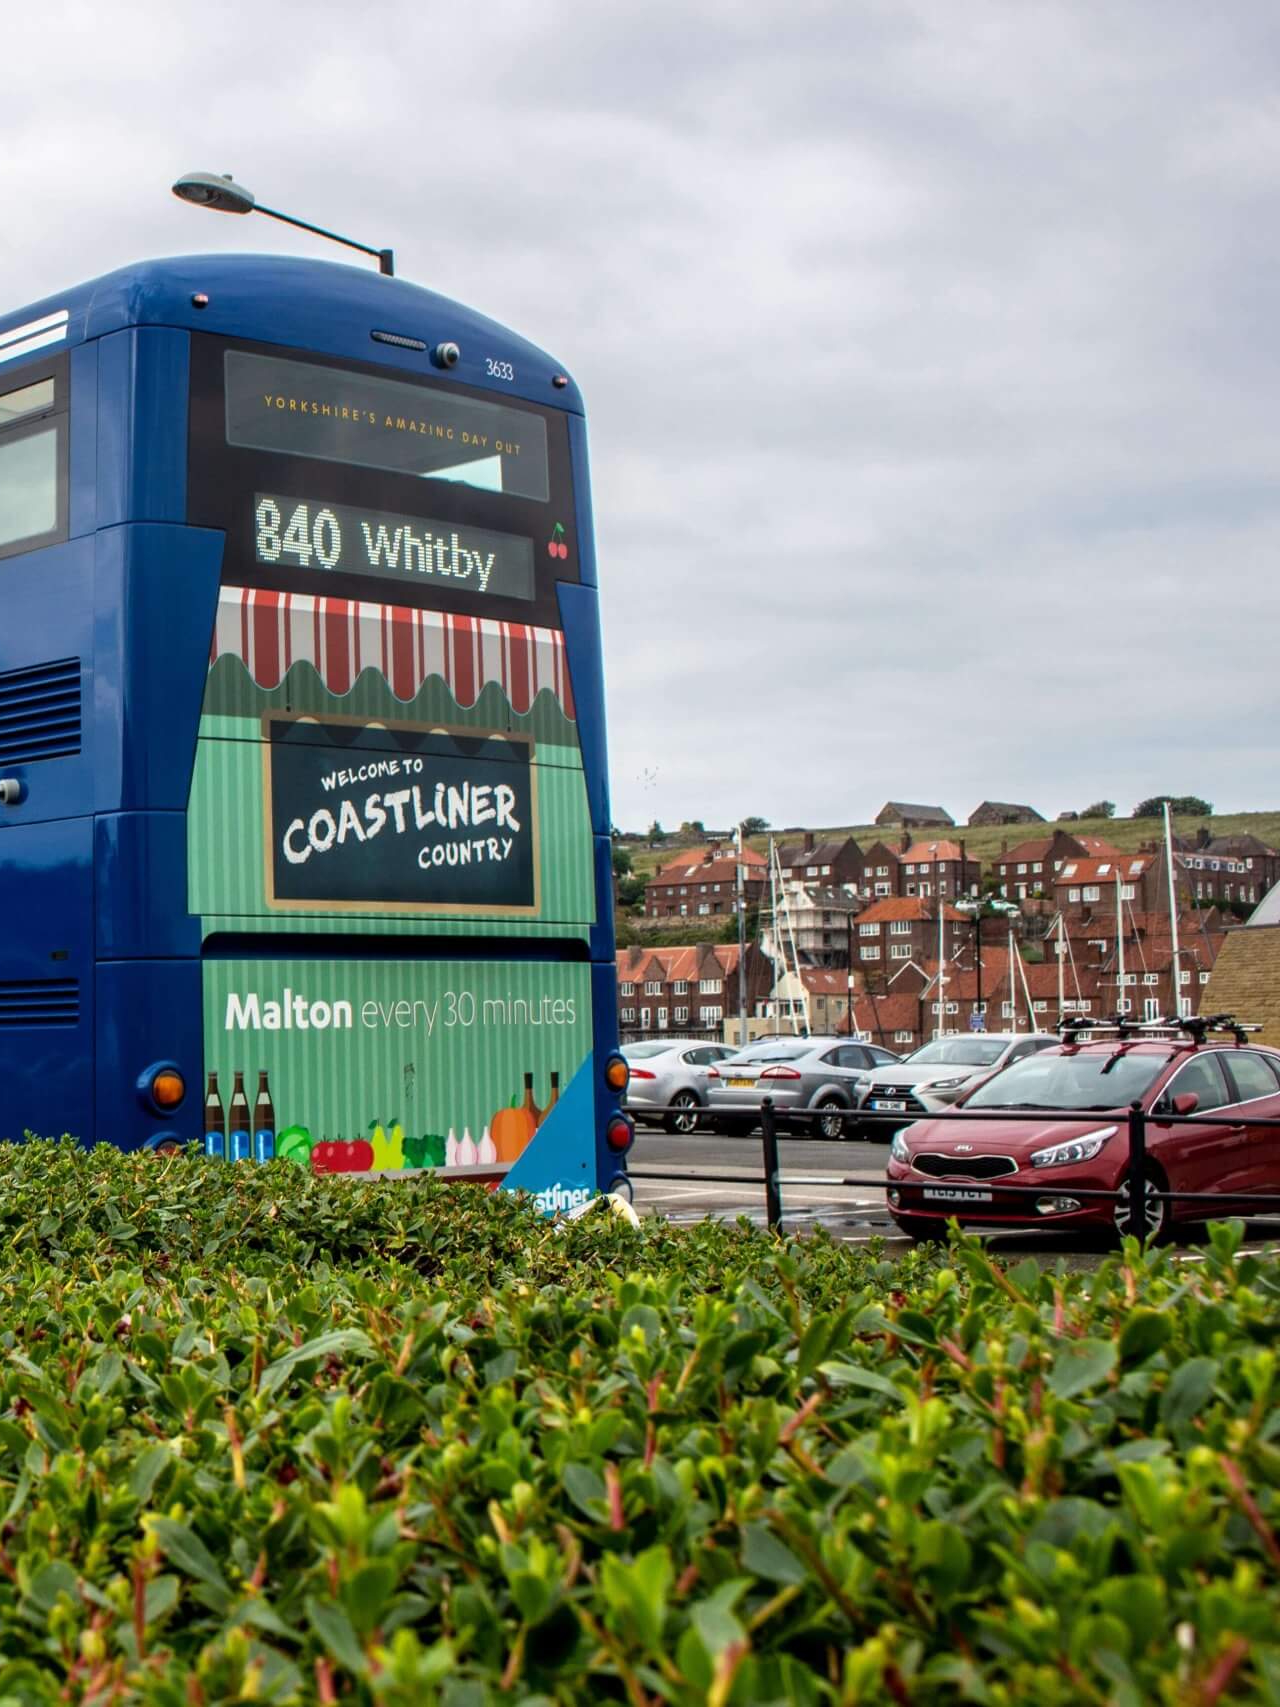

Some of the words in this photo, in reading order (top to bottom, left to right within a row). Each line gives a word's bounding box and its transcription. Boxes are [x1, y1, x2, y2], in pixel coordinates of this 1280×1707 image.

[485, 357, 514, 381] 3633
[264, 395, 376, 424] YORKSHIRE'S
[384, 415, 454, 440] AMAZING
[461, 431, 488, 447] DAY
[495, 440, 520, 455] OUT
[256, 498, 342, 568] 840
[360, 521, 496, 592] Whitby
[321, 760, 400, 791] WELCOME
[402, 758, 424, 774] TO
[283, 781, 521, 864] COASTLINER
[418, 837, 513, 869] COUNTRY
[225, 988, 352, 1030] Malton
[361, 999, 438, 1037] every
[443, 991, 476, 1027] 30
[482, 991, 576, 1026] minutes
